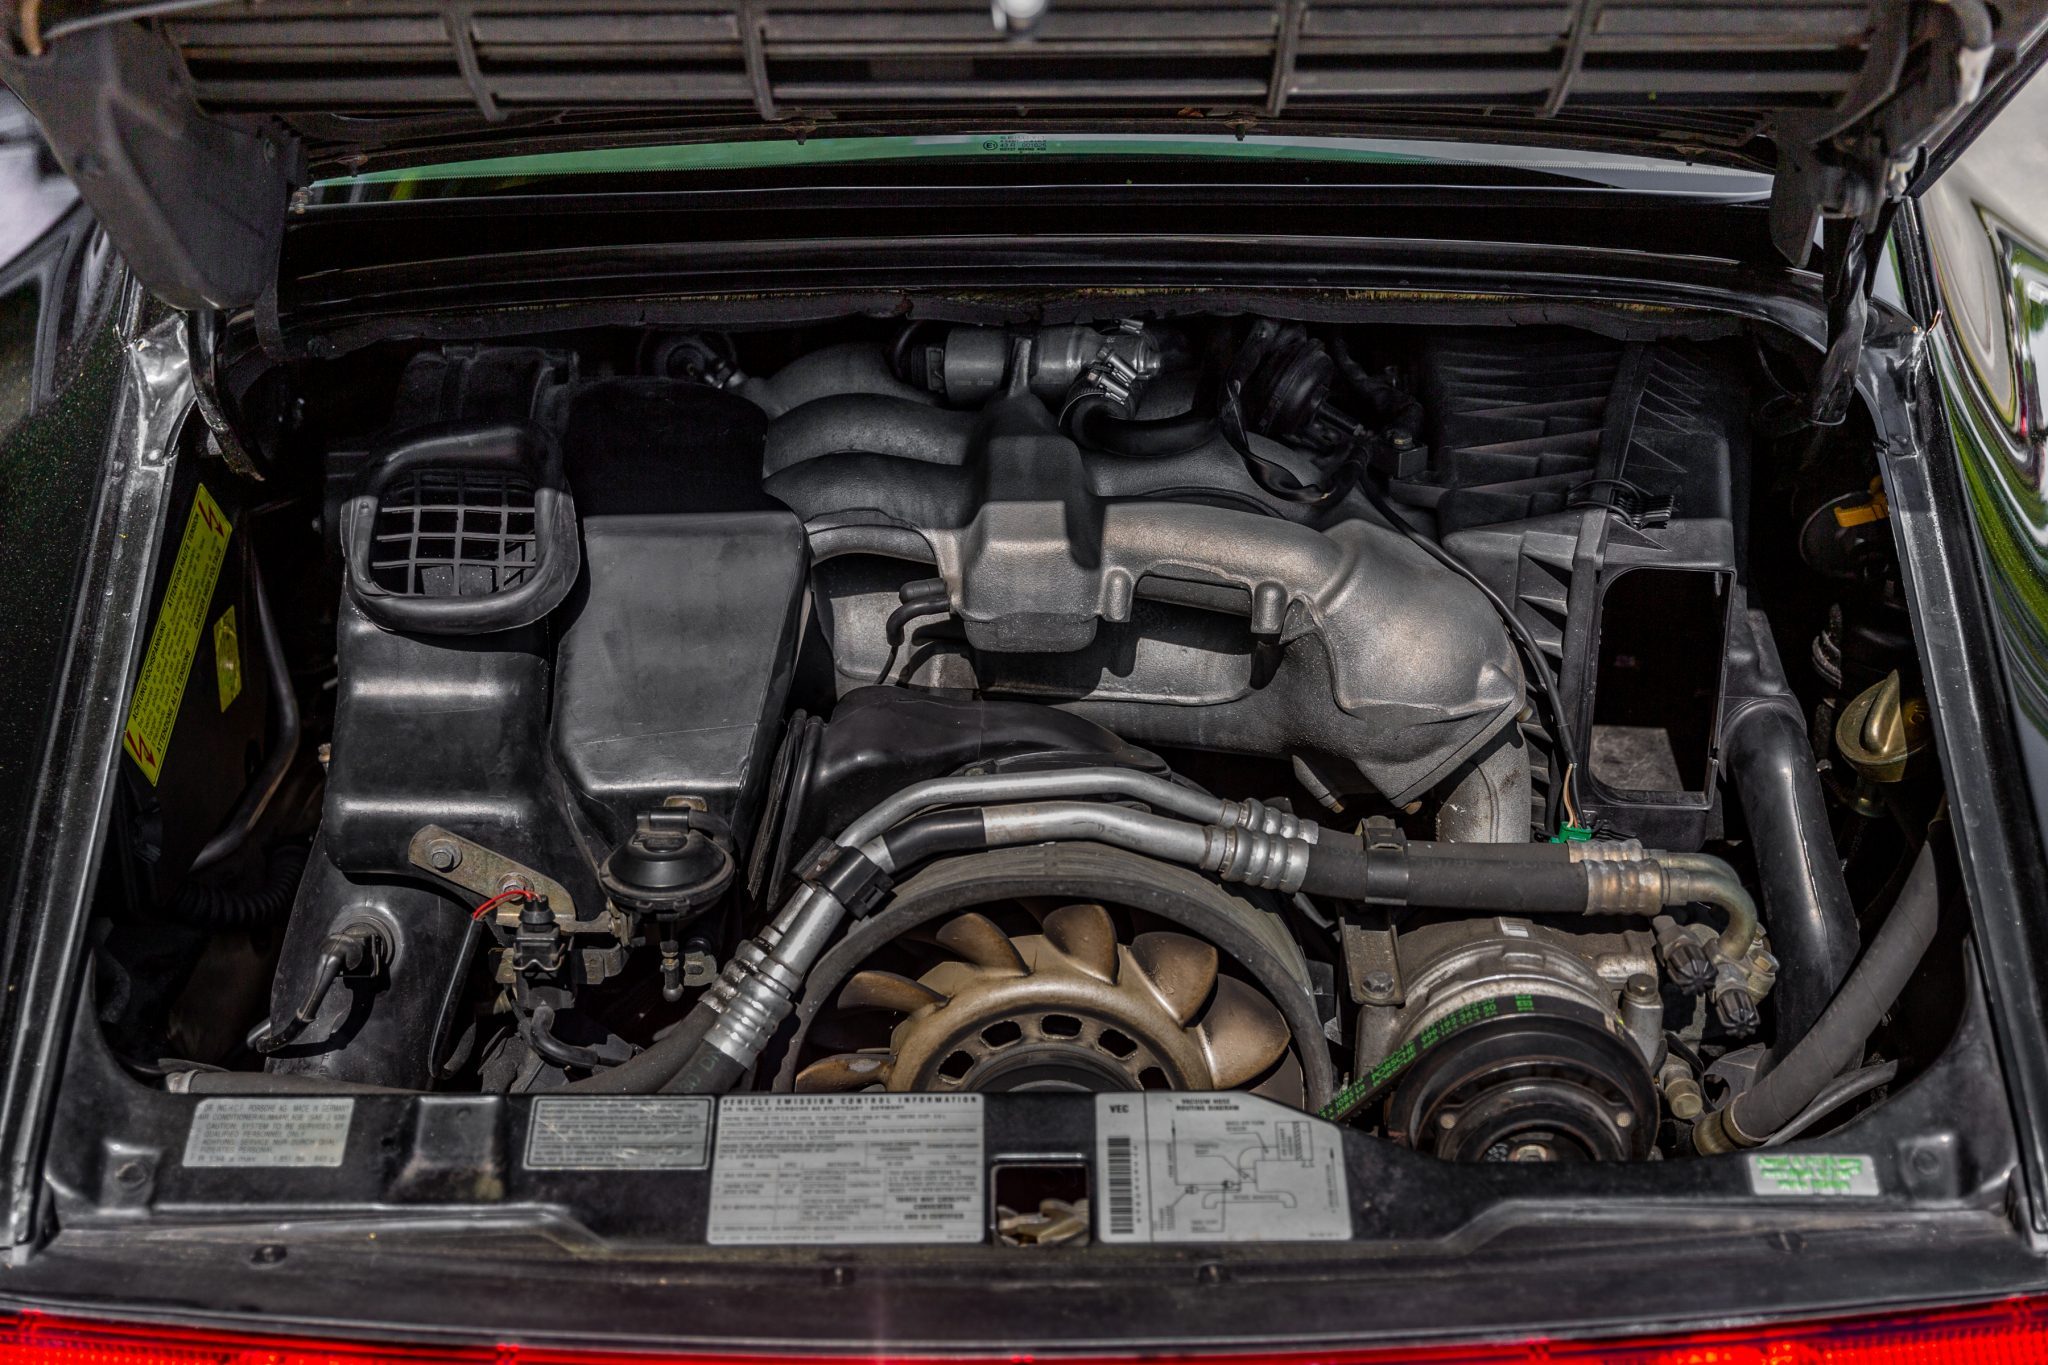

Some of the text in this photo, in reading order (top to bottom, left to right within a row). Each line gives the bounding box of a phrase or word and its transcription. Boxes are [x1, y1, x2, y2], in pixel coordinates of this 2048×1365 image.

[167, 567, 182, 609] ATTENTION
[132, 618, 166, 722] ACHTUNG HOCHSPANNUNG
[156, 705, 173, 754] ATTENZIONE
[170, 684, 179, 707] ALTA
[249, 1104, 275, 1112] PORSCHE
[1109, 1104, 1129, 1113] VEC
